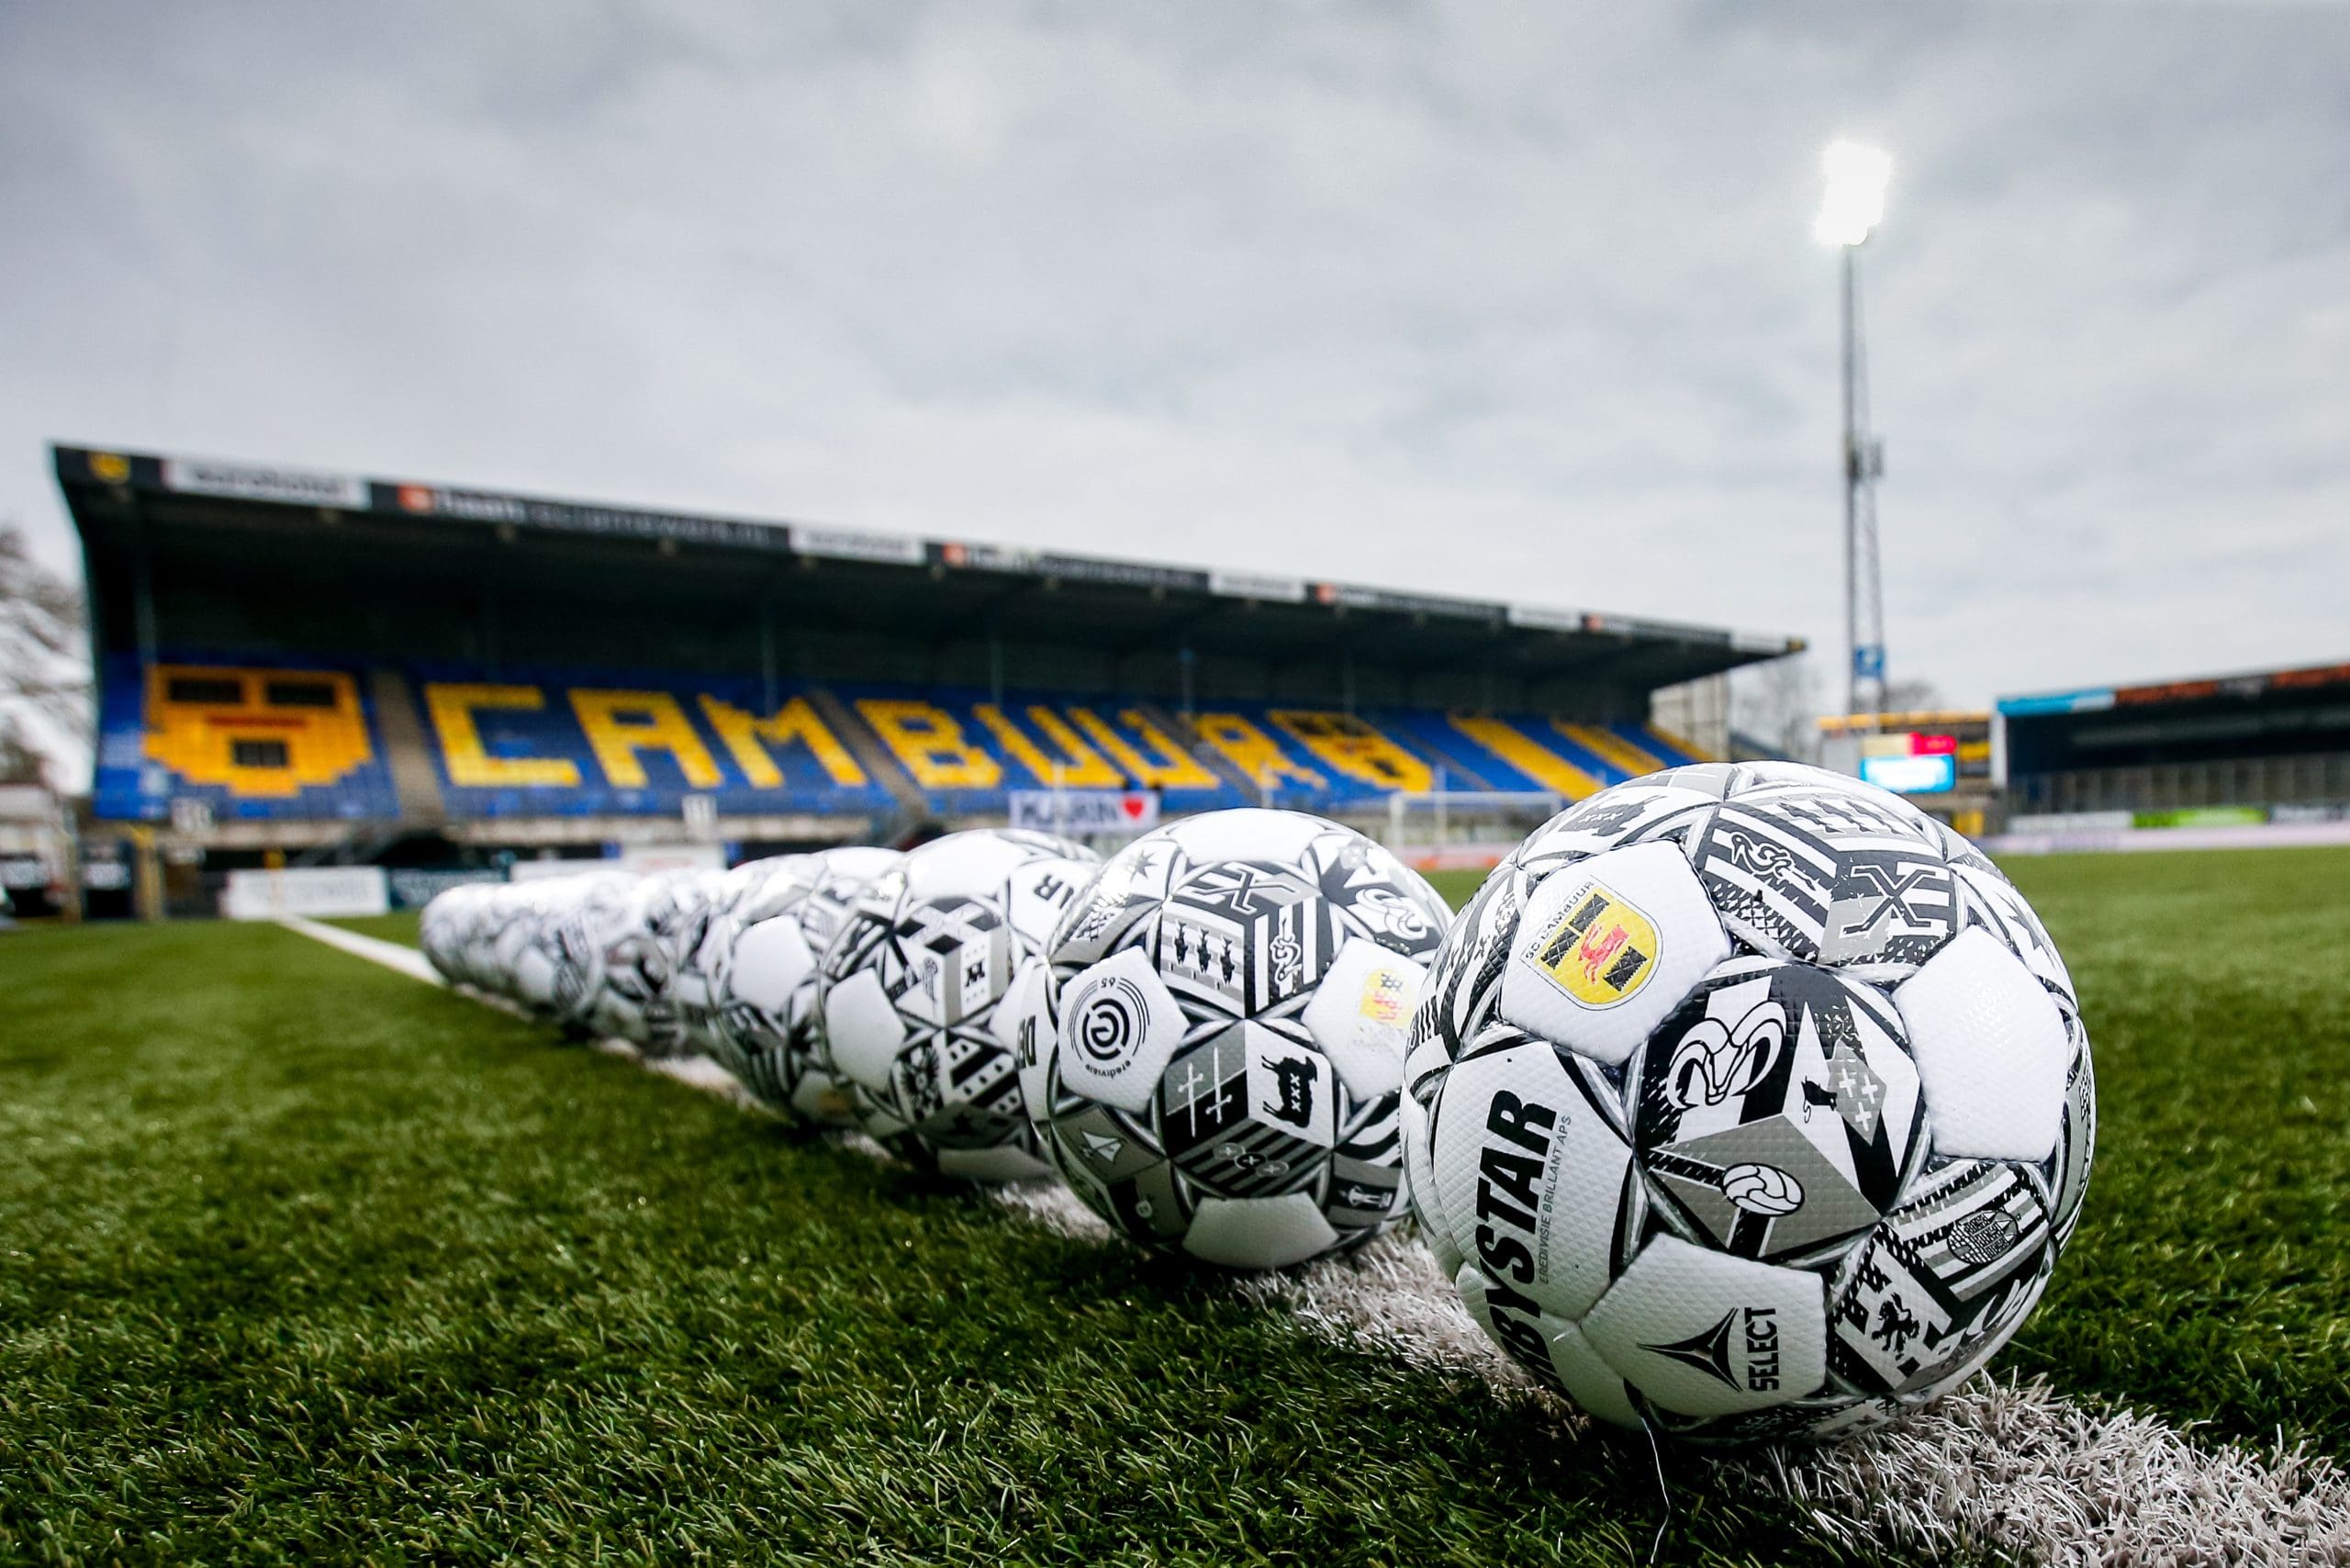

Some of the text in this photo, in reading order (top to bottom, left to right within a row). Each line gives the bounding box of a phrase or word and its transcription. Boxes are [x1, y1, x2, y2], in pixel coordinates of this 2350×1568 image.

[424, 682, 1328, 790] CAMBUUR
[1526, 942, 1540, 959] SC
[1474, 1090, 1568, 1388] RBYSTAR
[1539, 1115, 1572, 1286] EREDIVISIE BRILLANT APS
[1744, 1307, 1780, 1393] SELECT
